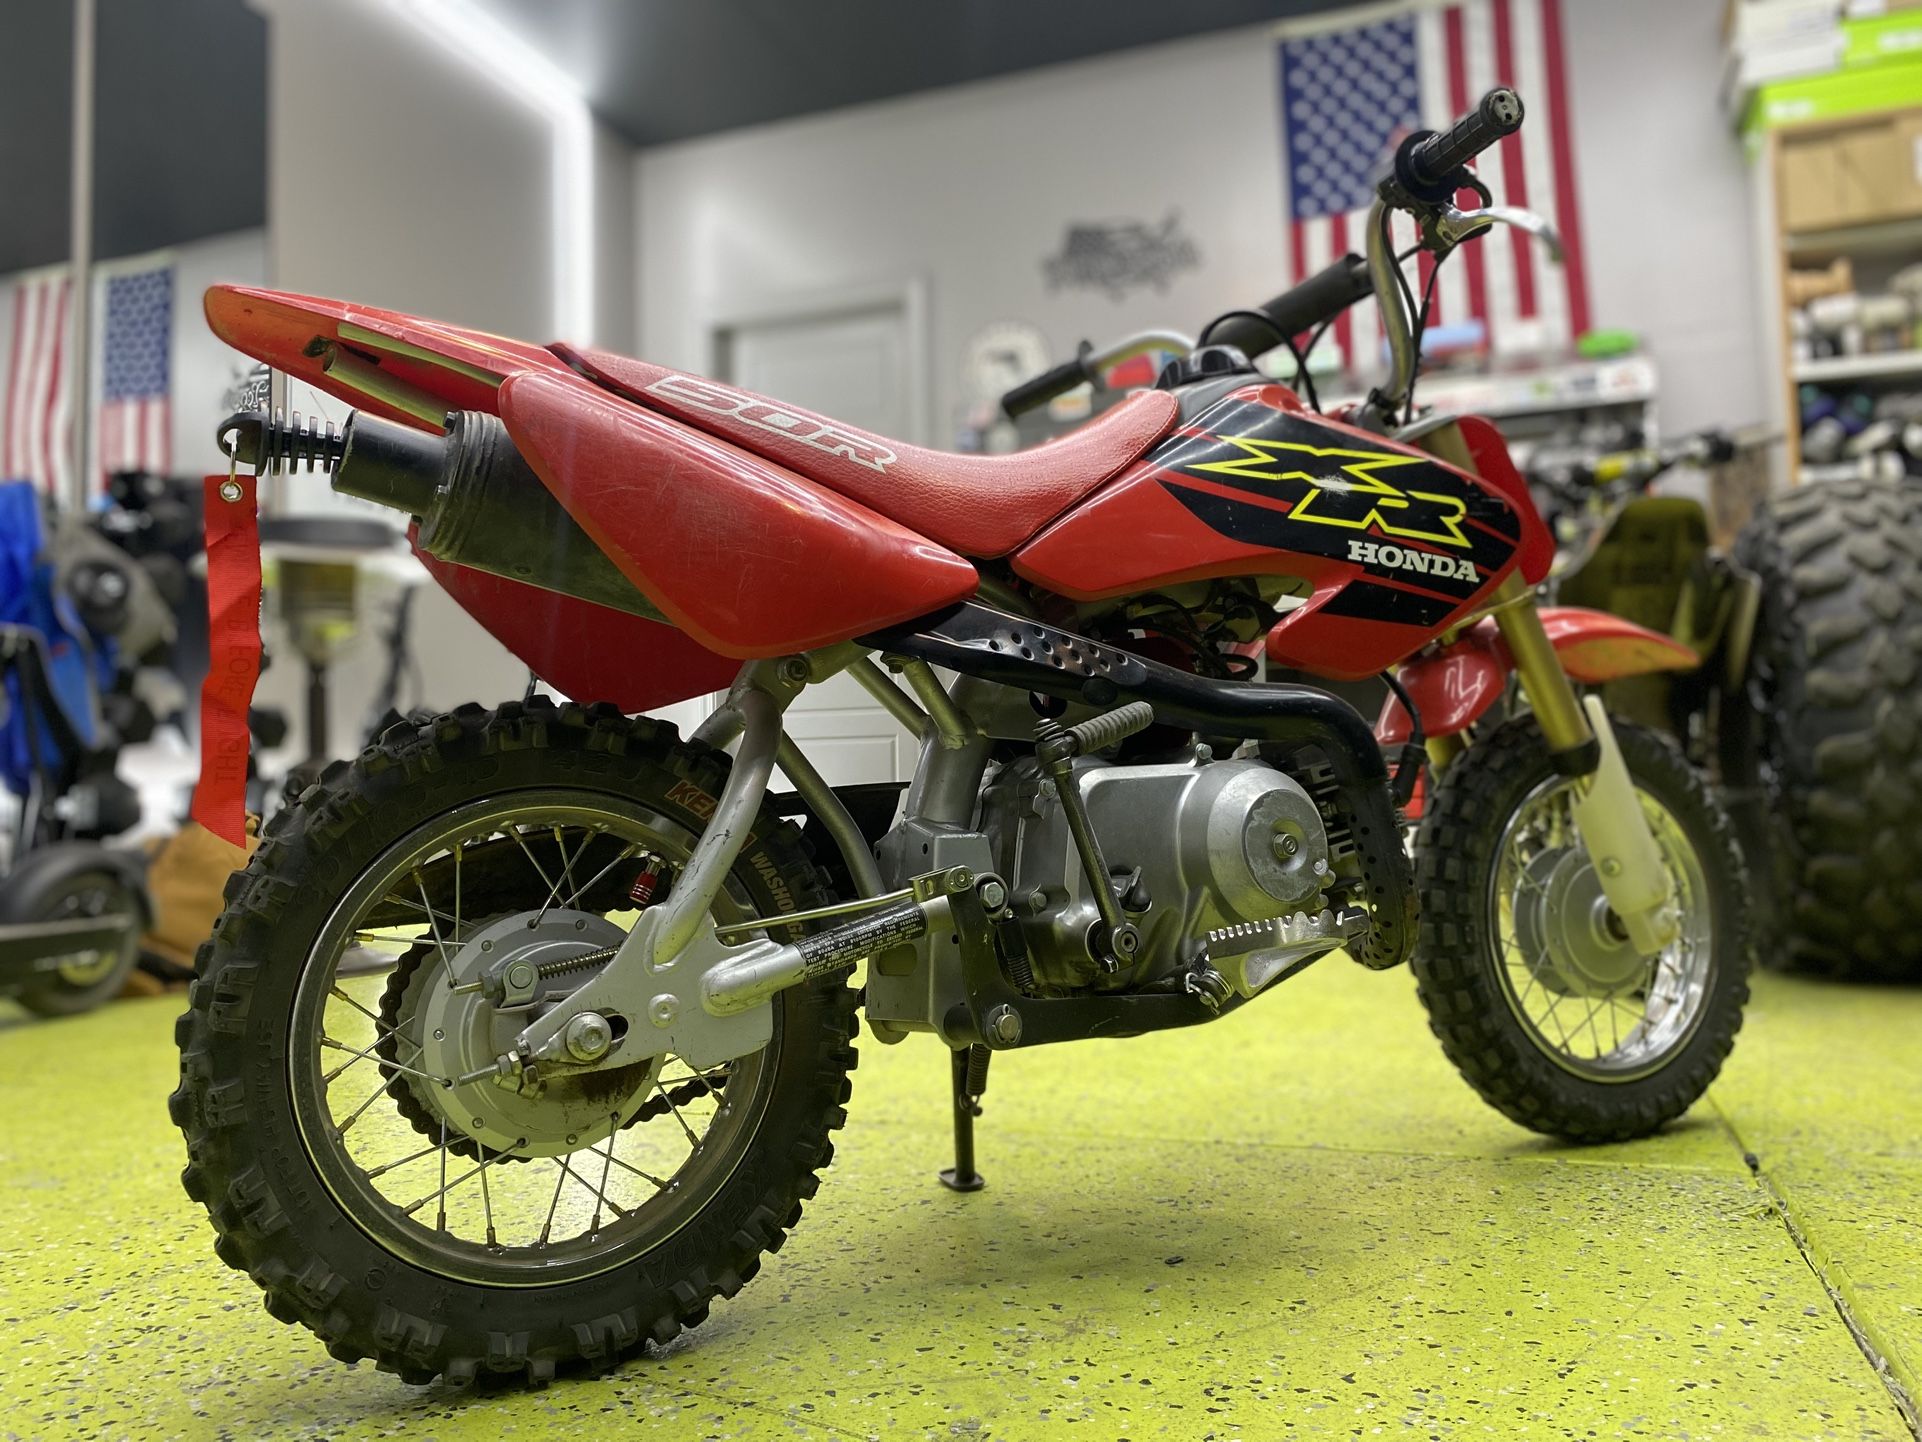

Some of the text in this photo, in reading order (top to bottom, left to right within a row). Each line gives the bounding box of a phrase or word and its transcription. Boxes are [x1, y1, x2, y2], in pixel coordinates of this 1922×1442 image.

[645, 374, 898, 474] 50R
[1184, 434, 1474, 549] XR
[1347, 538, 1480, 584] HONDA
[887, 923, 896, 931] THE
[900, 915, 920, 927] FEDERAL
[804, 944, 820, 953] MEETS
[808, 955, 820, 963] TEST
[860, 928, 896, 946] MODIFICATIONS
[843, 942, 873, 957] MOTORCYCLE
